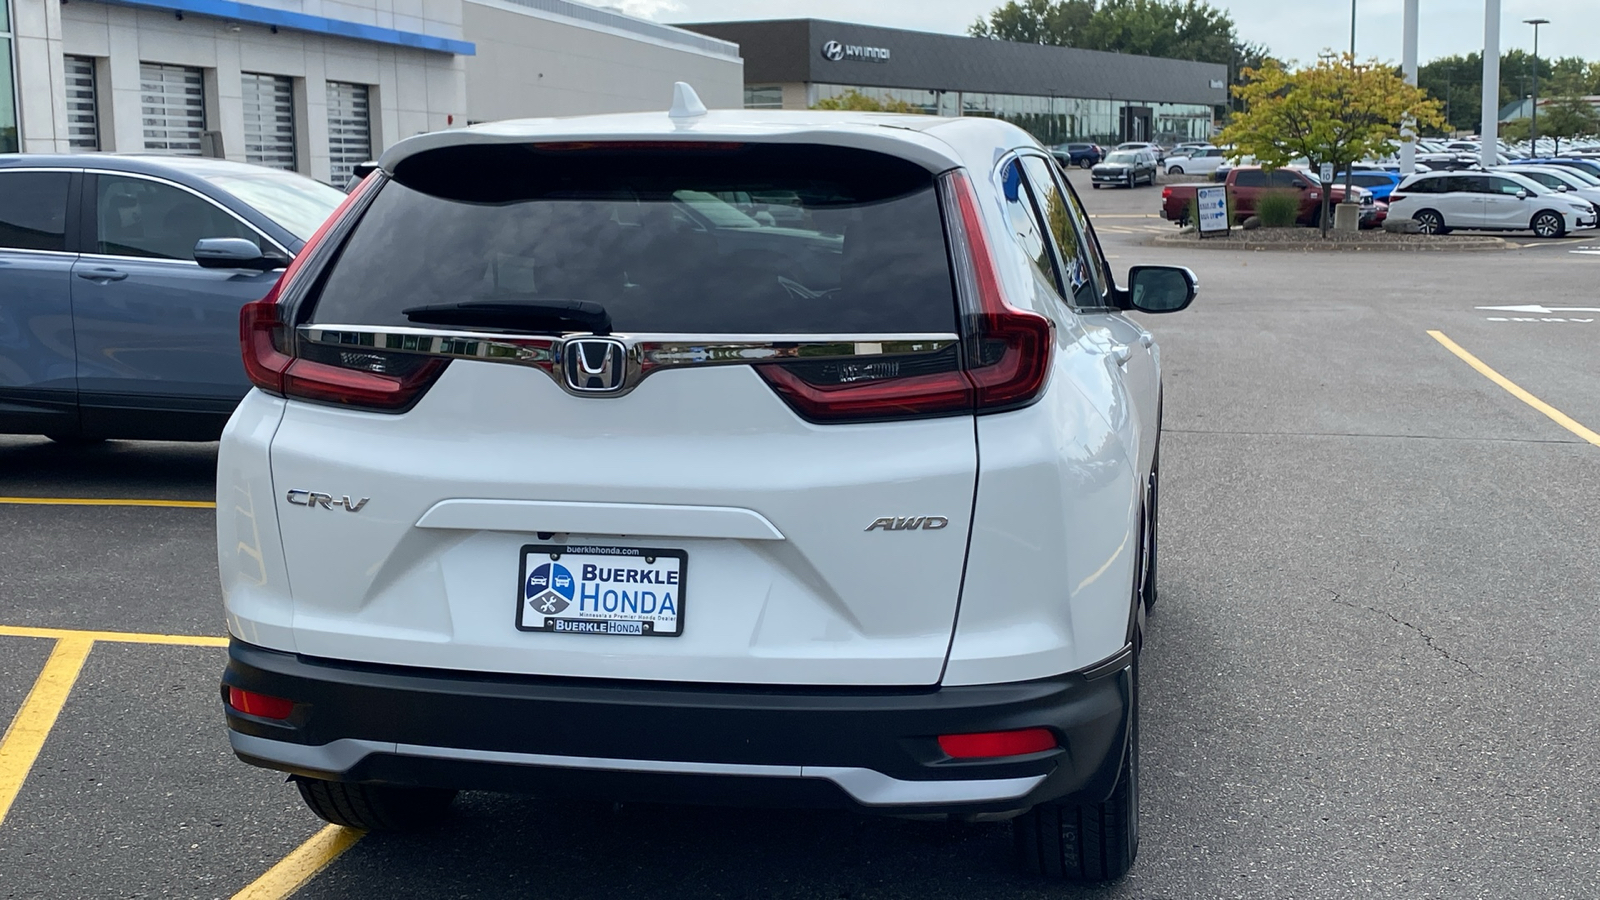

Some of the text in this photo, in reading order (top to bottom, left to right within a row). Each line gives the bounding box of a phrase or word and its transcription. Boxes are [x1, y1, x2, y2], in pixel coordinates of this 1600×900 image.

[1322, 173, 1331, 181] 10
[286, 488, 371, 513] CR-V
[864, 515, 949, 532] AWD
[566, 546, 640, 556] buerklehonda.com
[582, 563, 679, 585] BUERKLE
[579, 583, 676, 615] HONDA
[555, 619, 641, 634] BUERKLE HONDA
